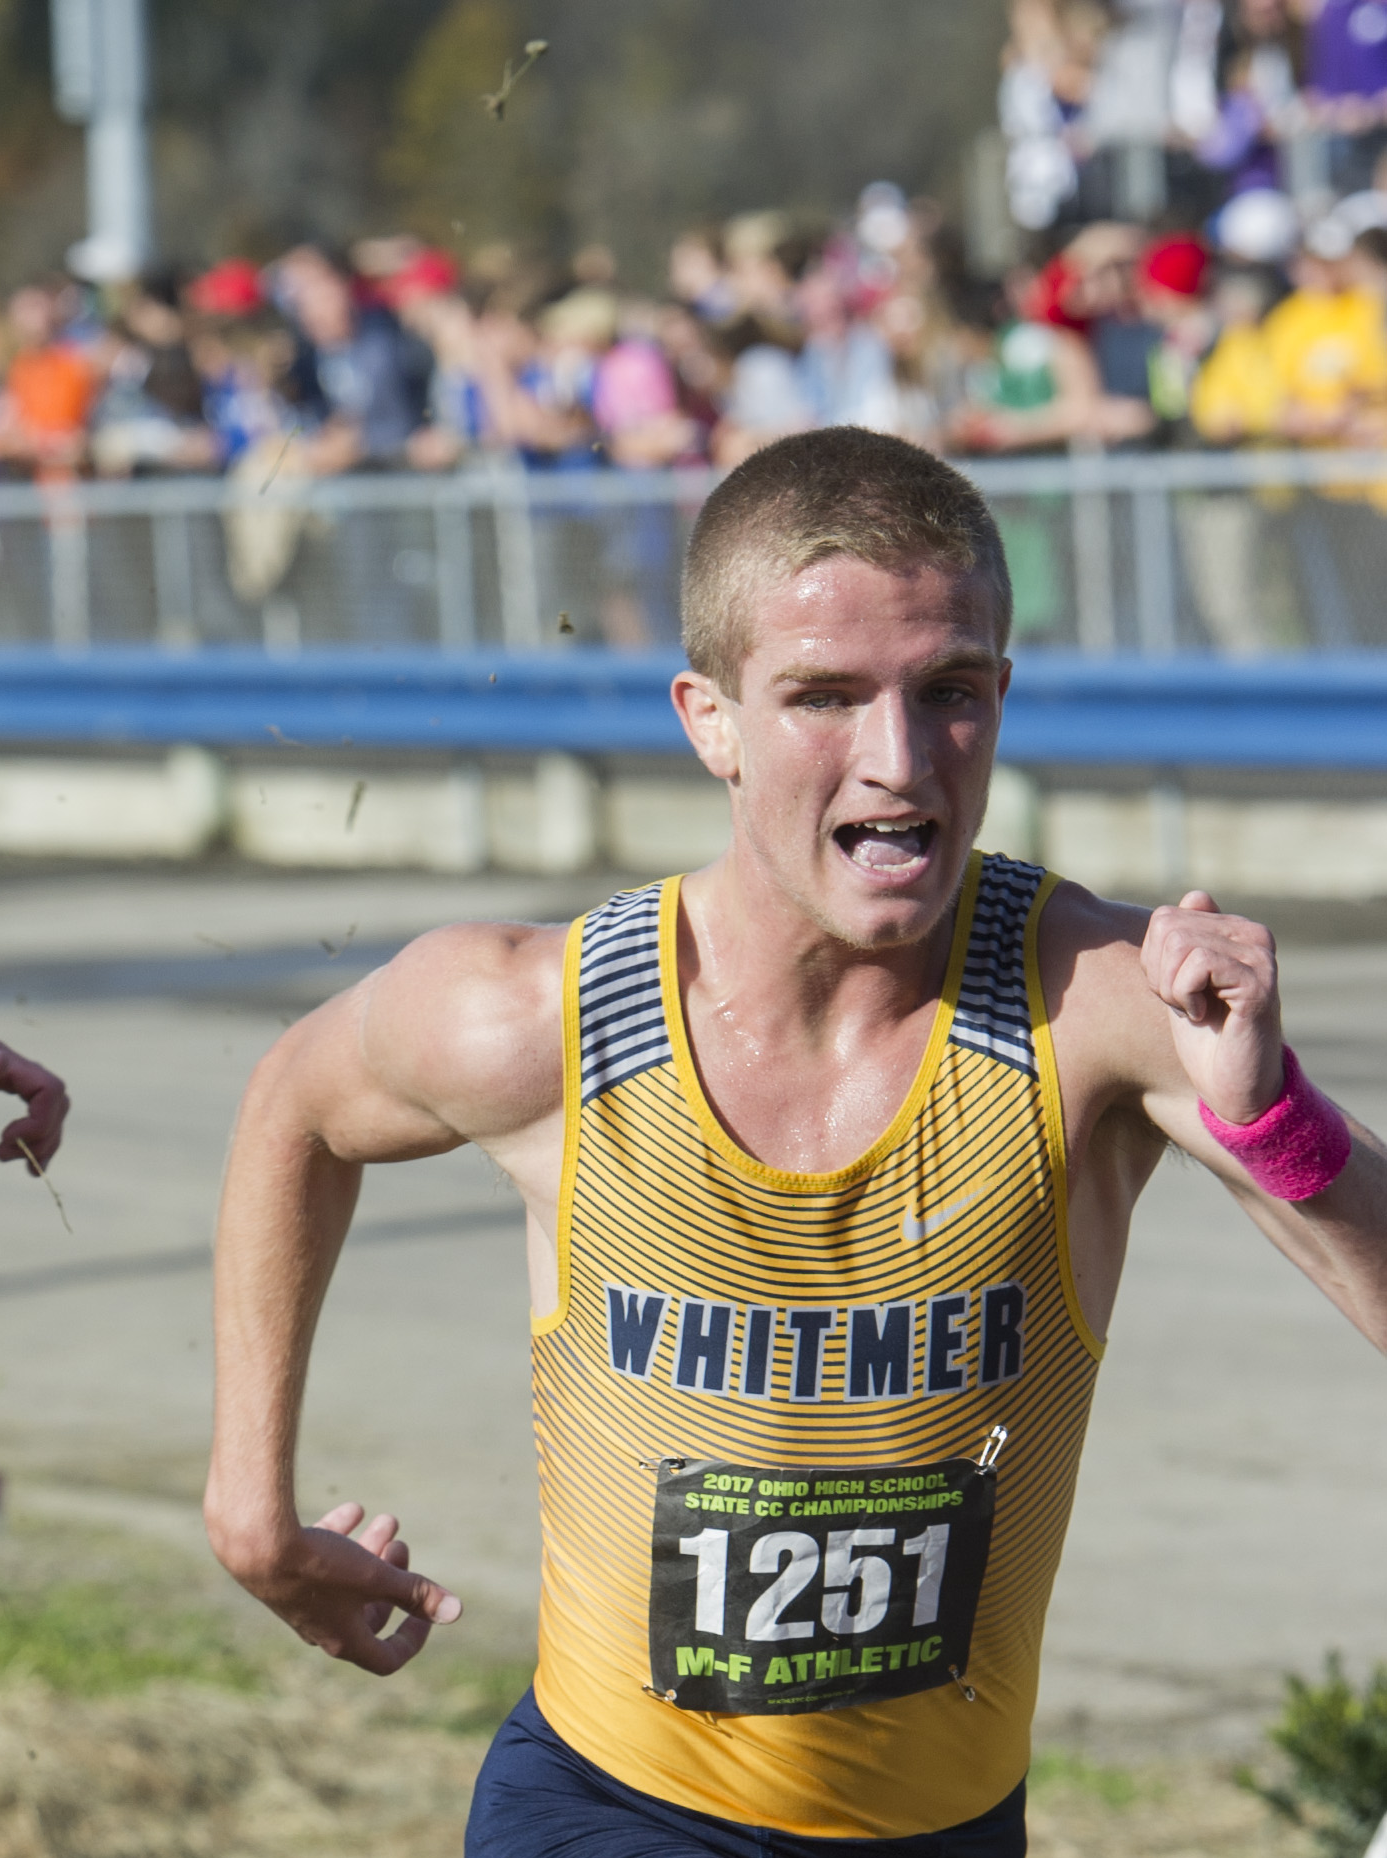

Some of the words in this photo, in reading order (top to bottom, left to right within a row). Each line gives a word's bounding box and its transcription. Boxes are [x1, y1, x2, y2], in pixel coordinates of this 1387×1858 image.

[603, 1278, 1029, 1402] WHITMER
[684, 1492, 750, 1515] STATE
[754, 1499, 784, 1517] CC
[789, 1490, 964, 1517] CHAMPIONSHIPS
[703, 1473, 754, 1493] 2017
[758, 1481, 810, 1497] OHIO
[814, 1480, 865, 1496] HIGH
[869, 1473, 949, 1494] SCHOOL
[679, 1522, 951, 1642] 1251
[675, 1645, 753, 1682] M-F
[763, 1635, 943, 1685] ATHLETIC
